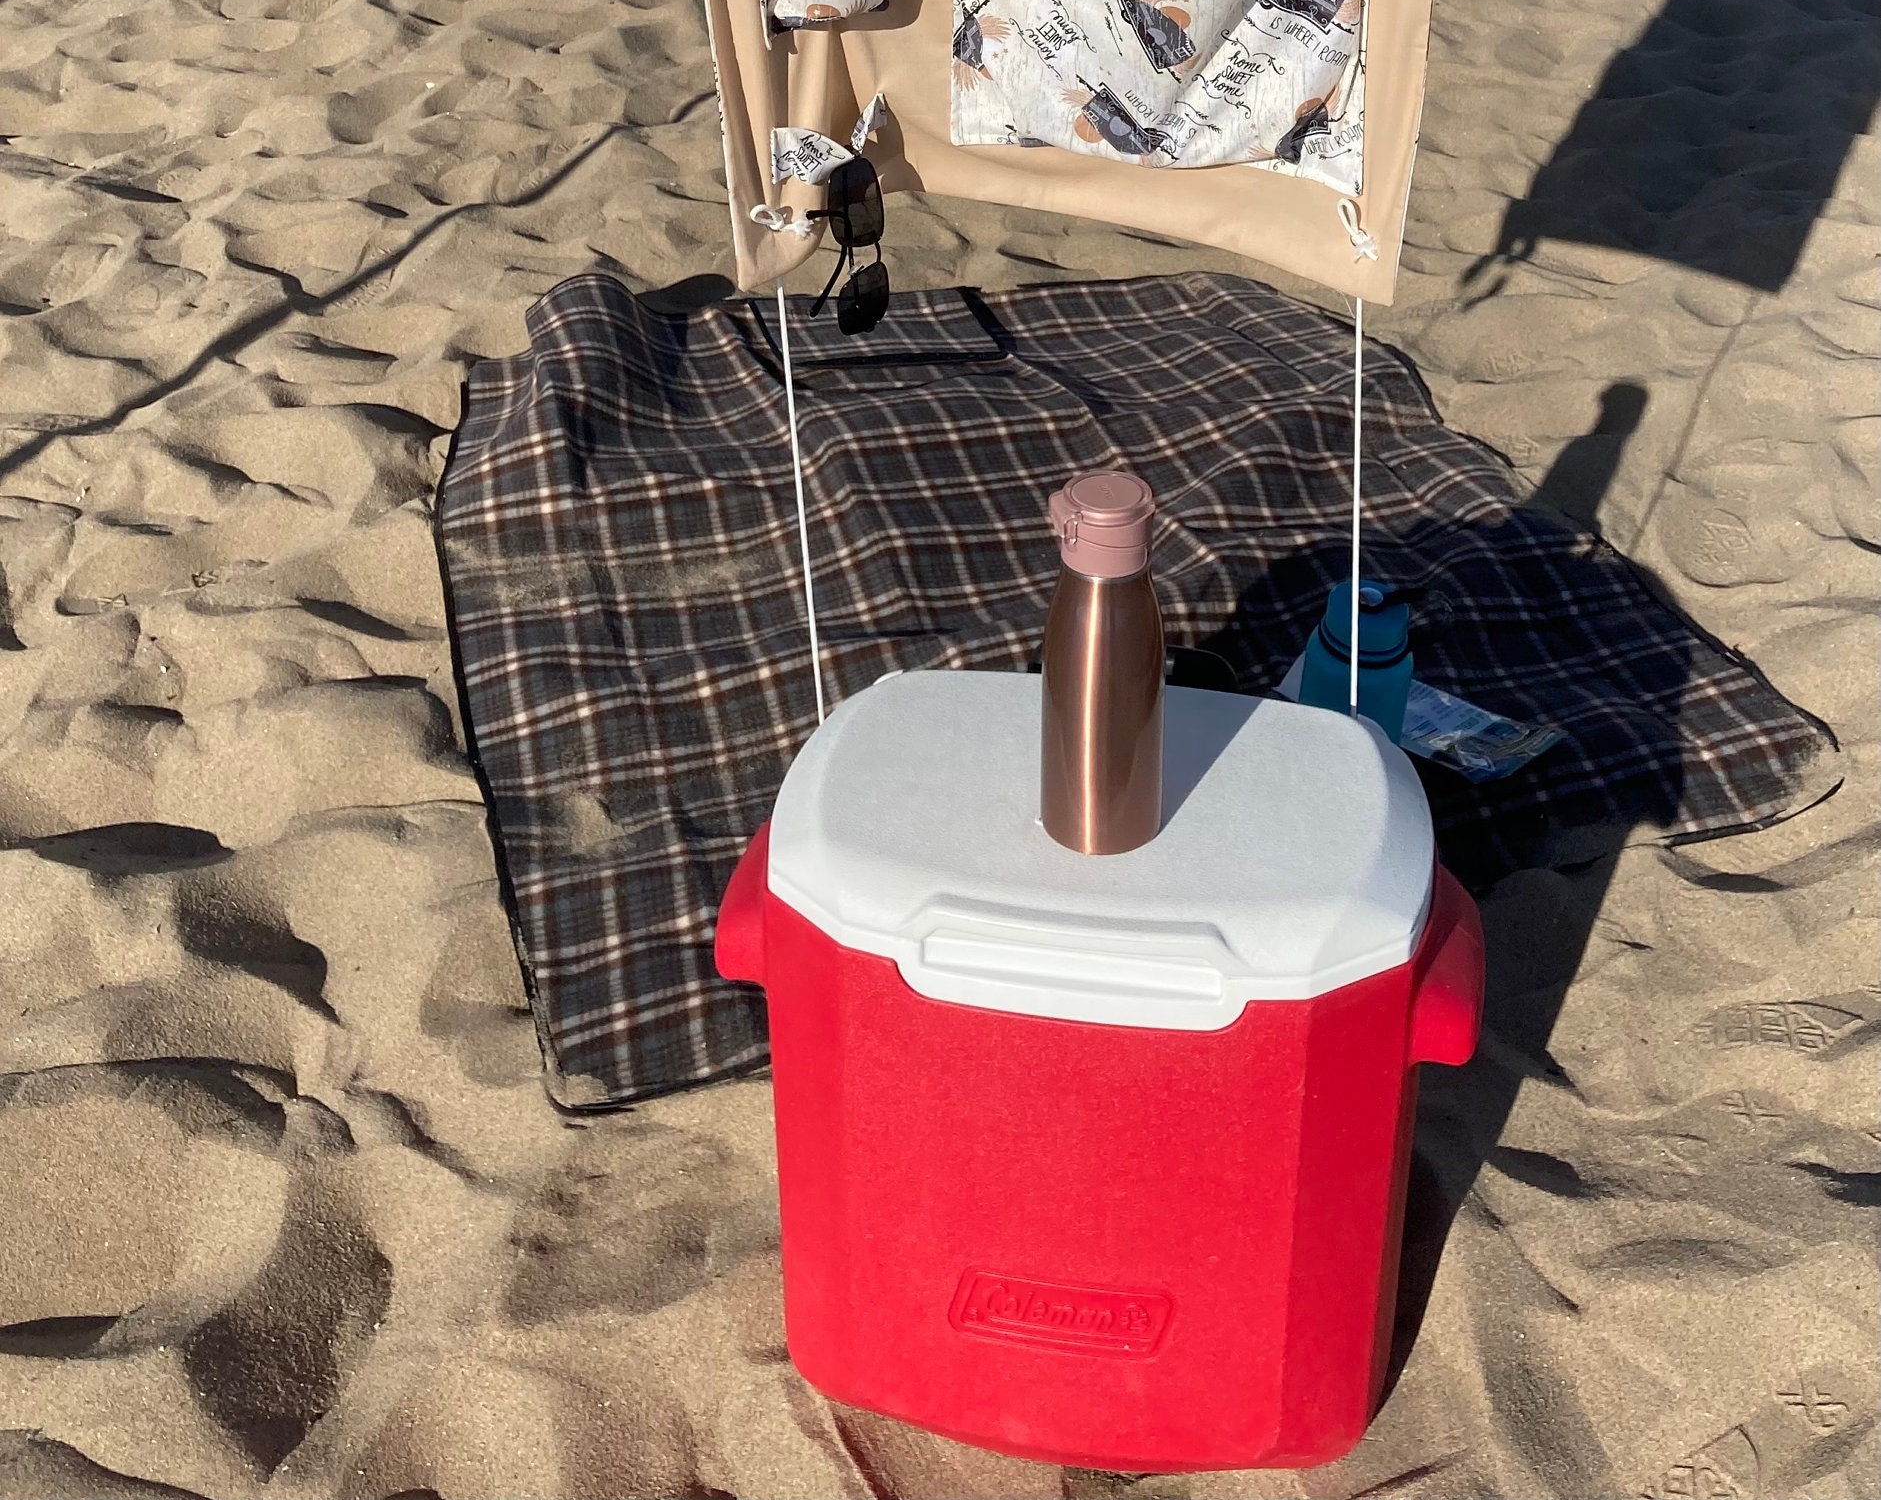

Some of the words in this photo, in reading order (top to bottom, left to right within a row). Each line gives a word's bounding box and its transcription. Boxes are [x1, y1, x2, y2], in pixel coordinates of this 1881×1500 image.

[1035, 21, 1067, 51] SWEET
[1048, 10, 1082, 45] home
[1268, 16, 1283, 30] IS
[1284, 19, 1317, 49] WHERE
[1318, 45, 1350, 67] ROAM
[1024, 28, 1058, 60] home
[1221, 64, 1255, 85] SWEET
[1228, 51, 1266, 74] home
[1210, 73, 1245, 97] home
[1124, 89, 1153, 120] ROAM
[793, 146, 822, 173] SWEET
[800, 134, 828, 161] home
[986, 1282, 1116, 1331] Coleman
